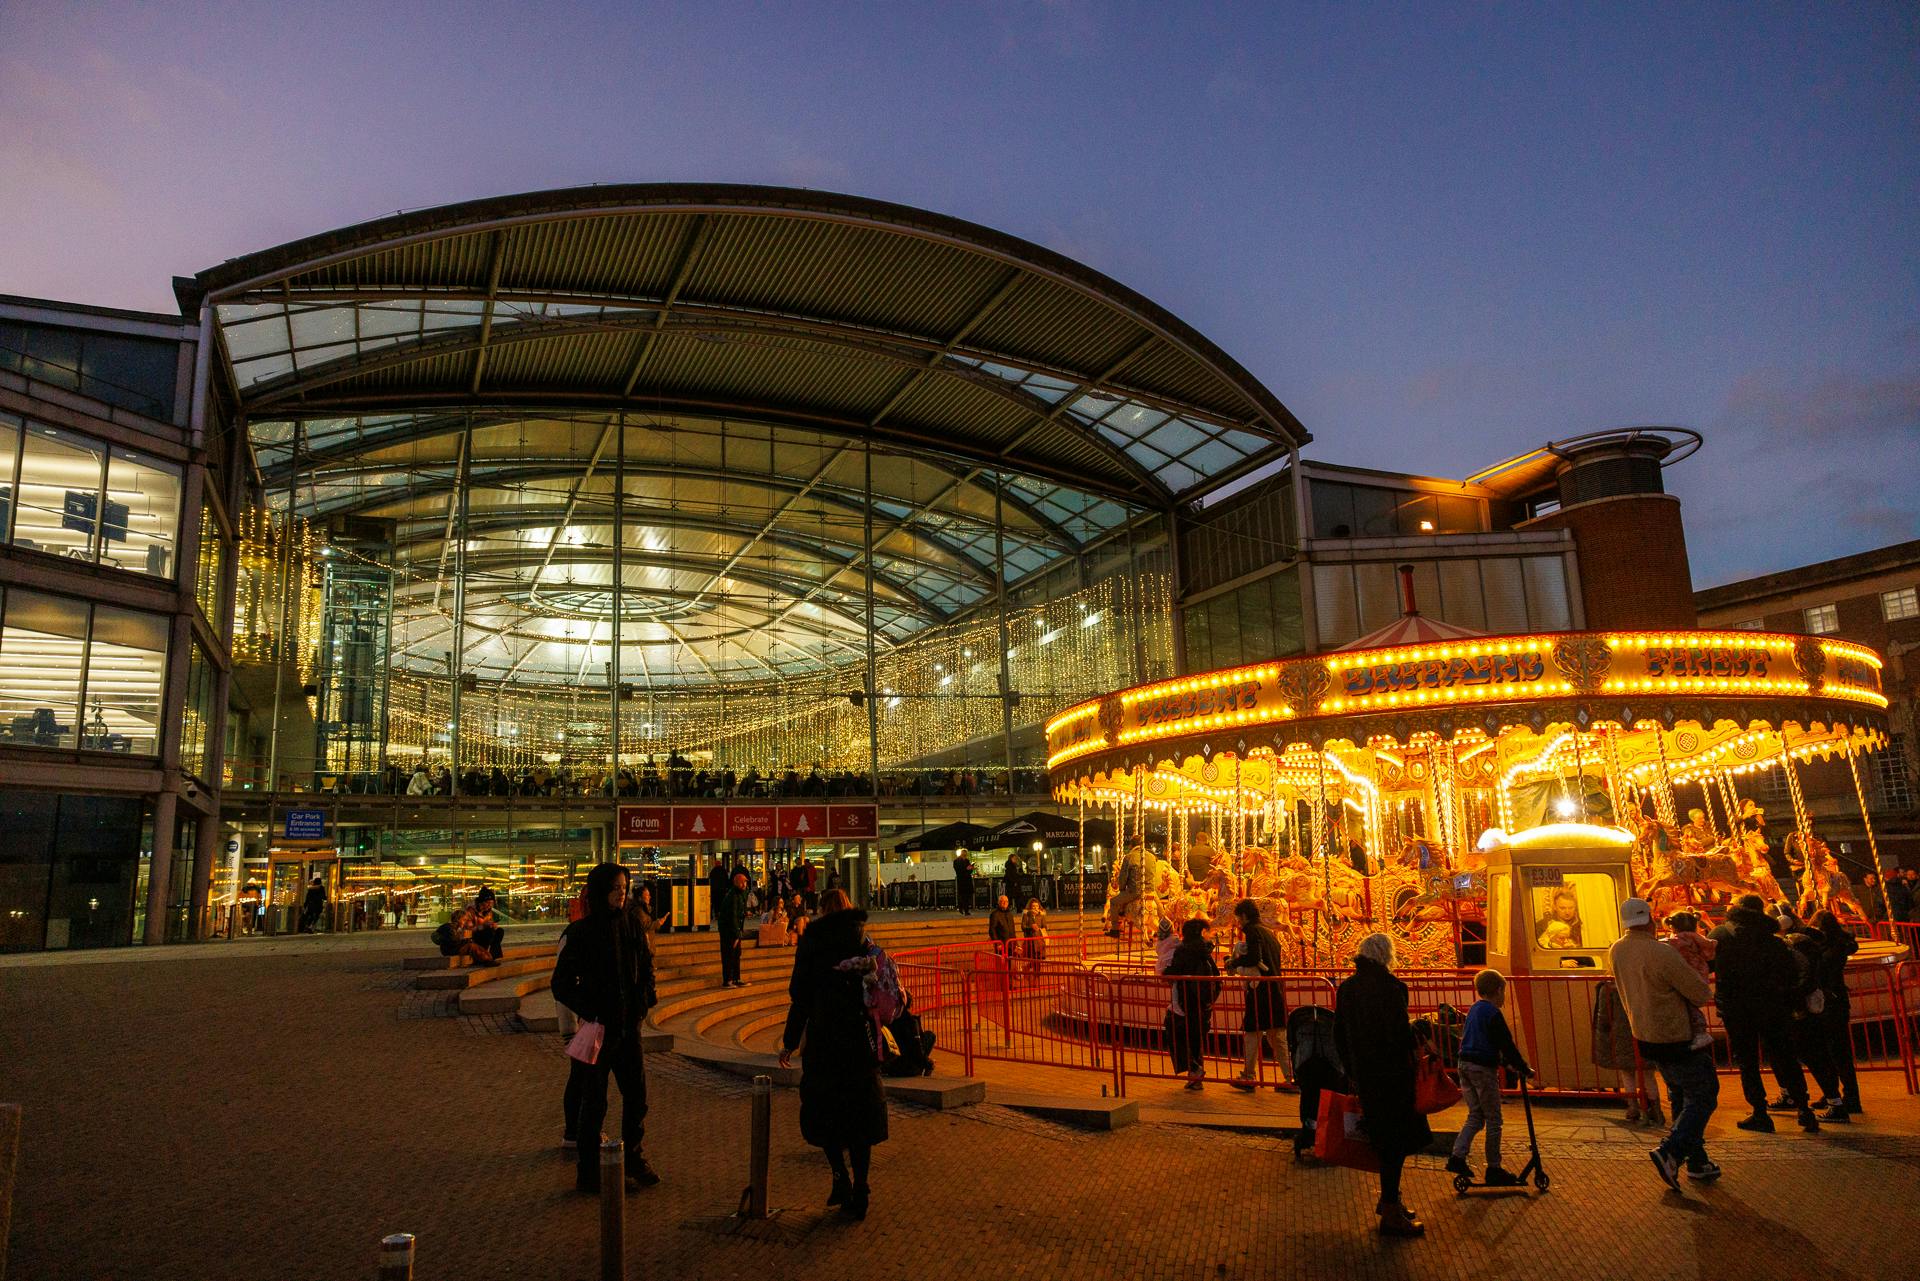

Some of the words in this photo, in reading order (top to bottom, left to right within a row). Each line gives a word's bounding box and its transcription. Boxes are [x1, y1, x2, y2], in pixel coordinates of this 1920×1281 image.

[1641, 647, 1772, 677] FINEST
[291, 812, 304, 820] Car
[734, 816, 769, 824] Celebrate
[1064, 882, 1103, 890] MARANO
